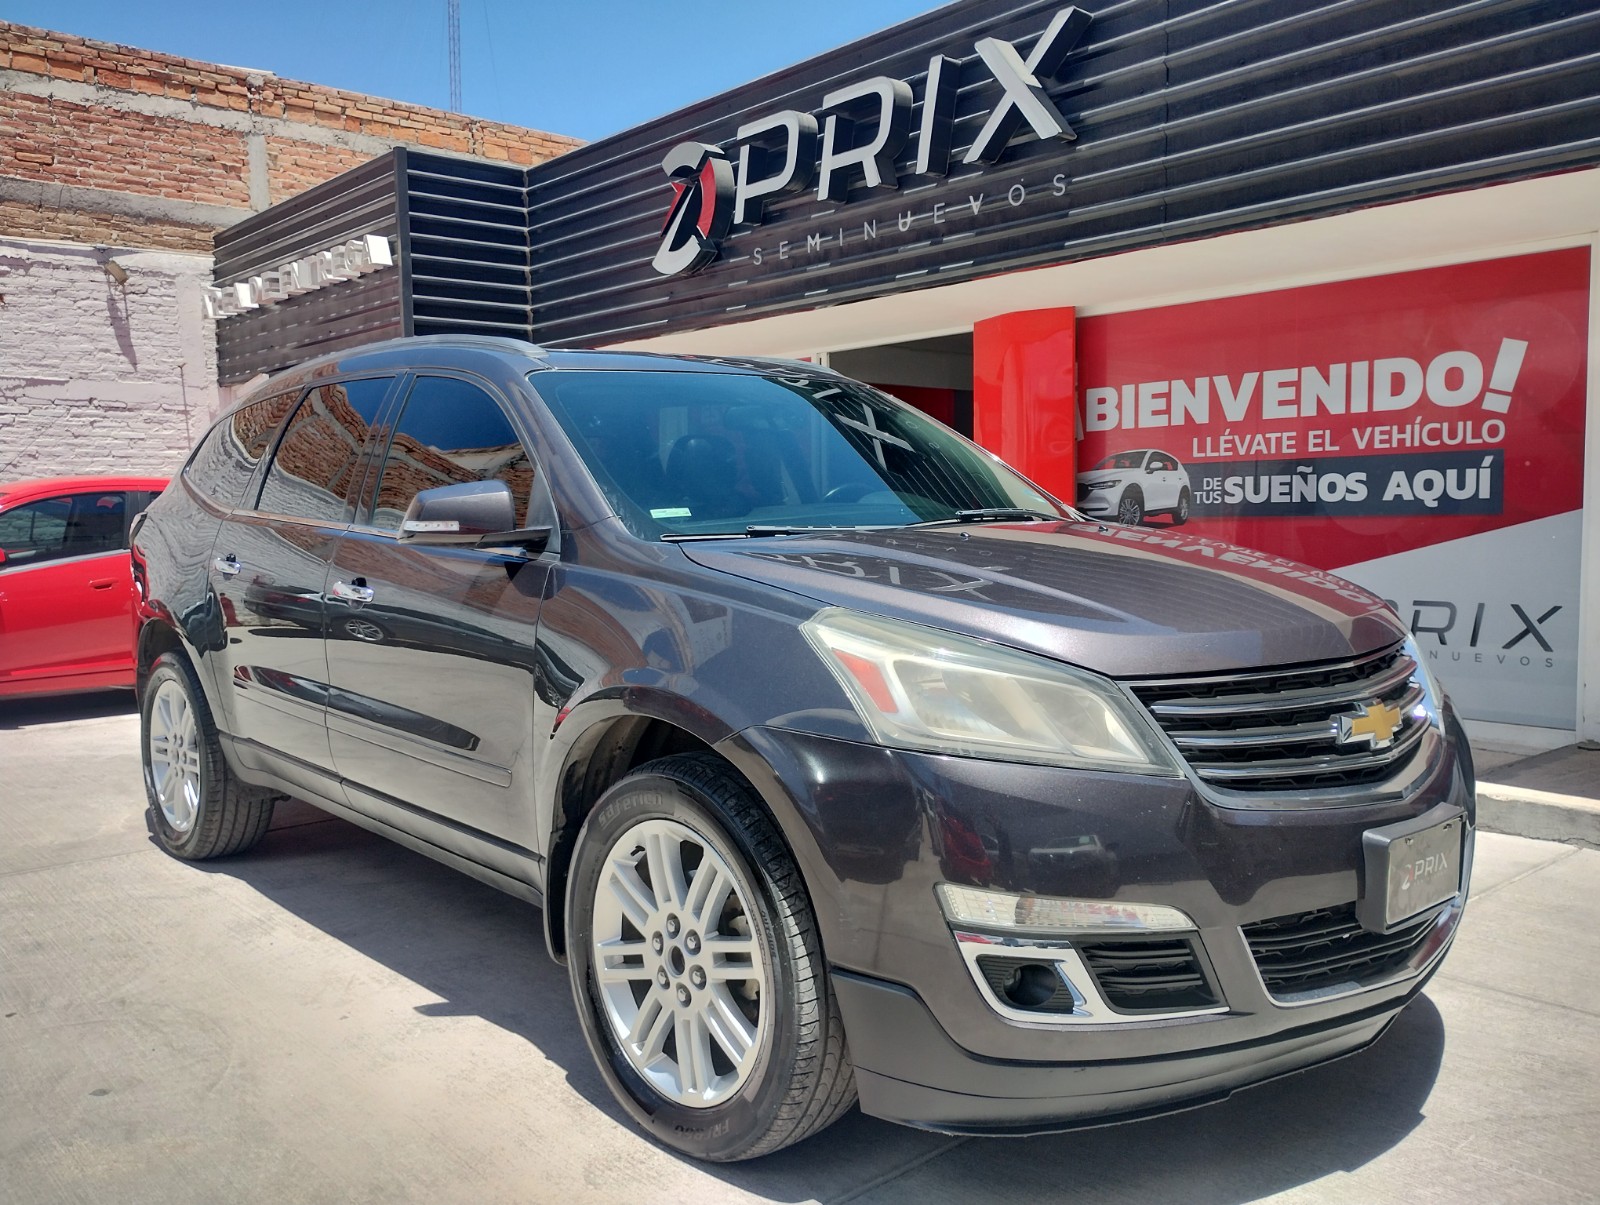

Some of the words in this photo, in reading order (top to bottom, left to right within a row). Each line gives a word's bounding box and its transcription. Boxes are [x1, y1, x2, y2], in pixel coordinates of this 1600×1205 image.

[752, 173, 1068, 266] SEMINUEVOS
[1192, 428, 1297, 457] LLÉVATE
[1308, 429, 1340, 452] EL
[1351, 415, 1506, 450] VEHÍCULO
[1194, 490, 1222, 504] TUS
[1203, 477, 1222, 490] DE
[1224, 465, 1368, 504] SUEÑOS
[1382, 455, 1494, 507] AQUÍ
[1384, 598, 1563, 653] RIX
[1429, 650, 1553, 668] NUEVOS
